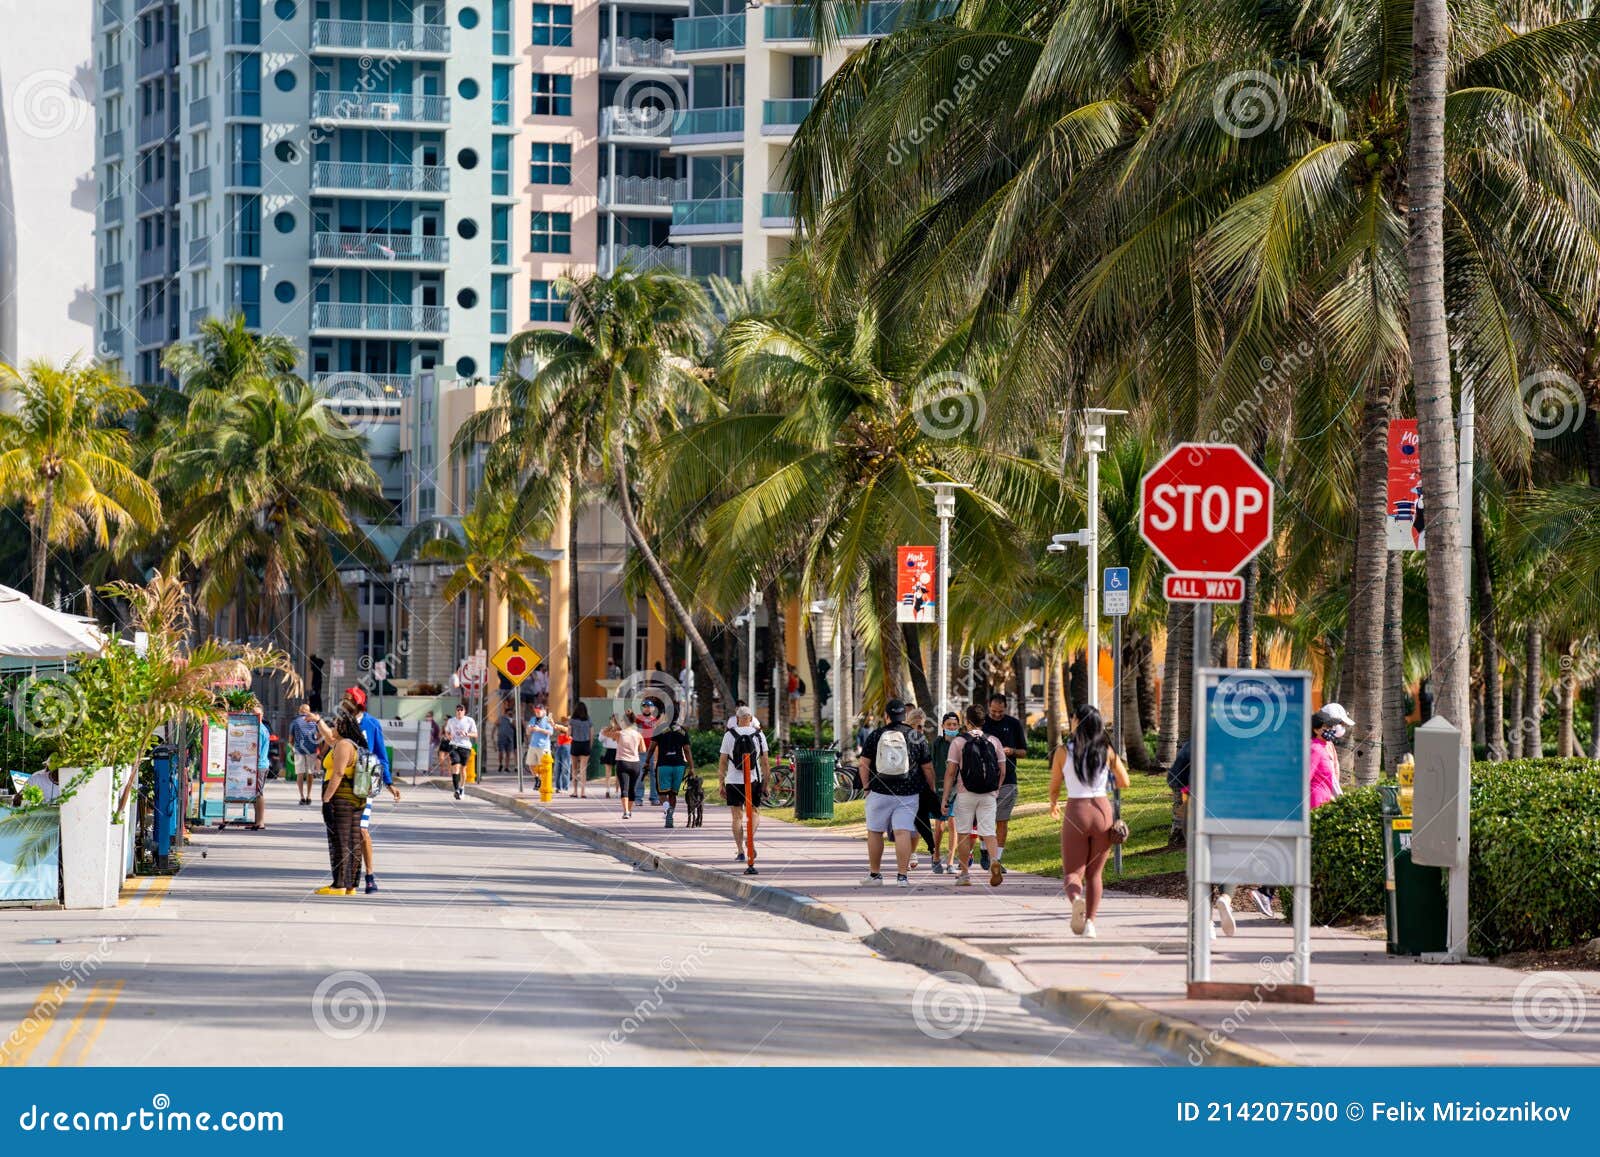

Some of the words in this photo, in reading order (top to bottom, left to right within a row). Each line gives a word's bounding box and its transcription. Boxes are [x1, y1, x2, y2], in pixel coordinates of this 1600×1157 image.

[1150, 483, 1264, 534] STOP
[1172, 579, 1199, 596] ALL
[1205, 580, 1236, 598] WAY
